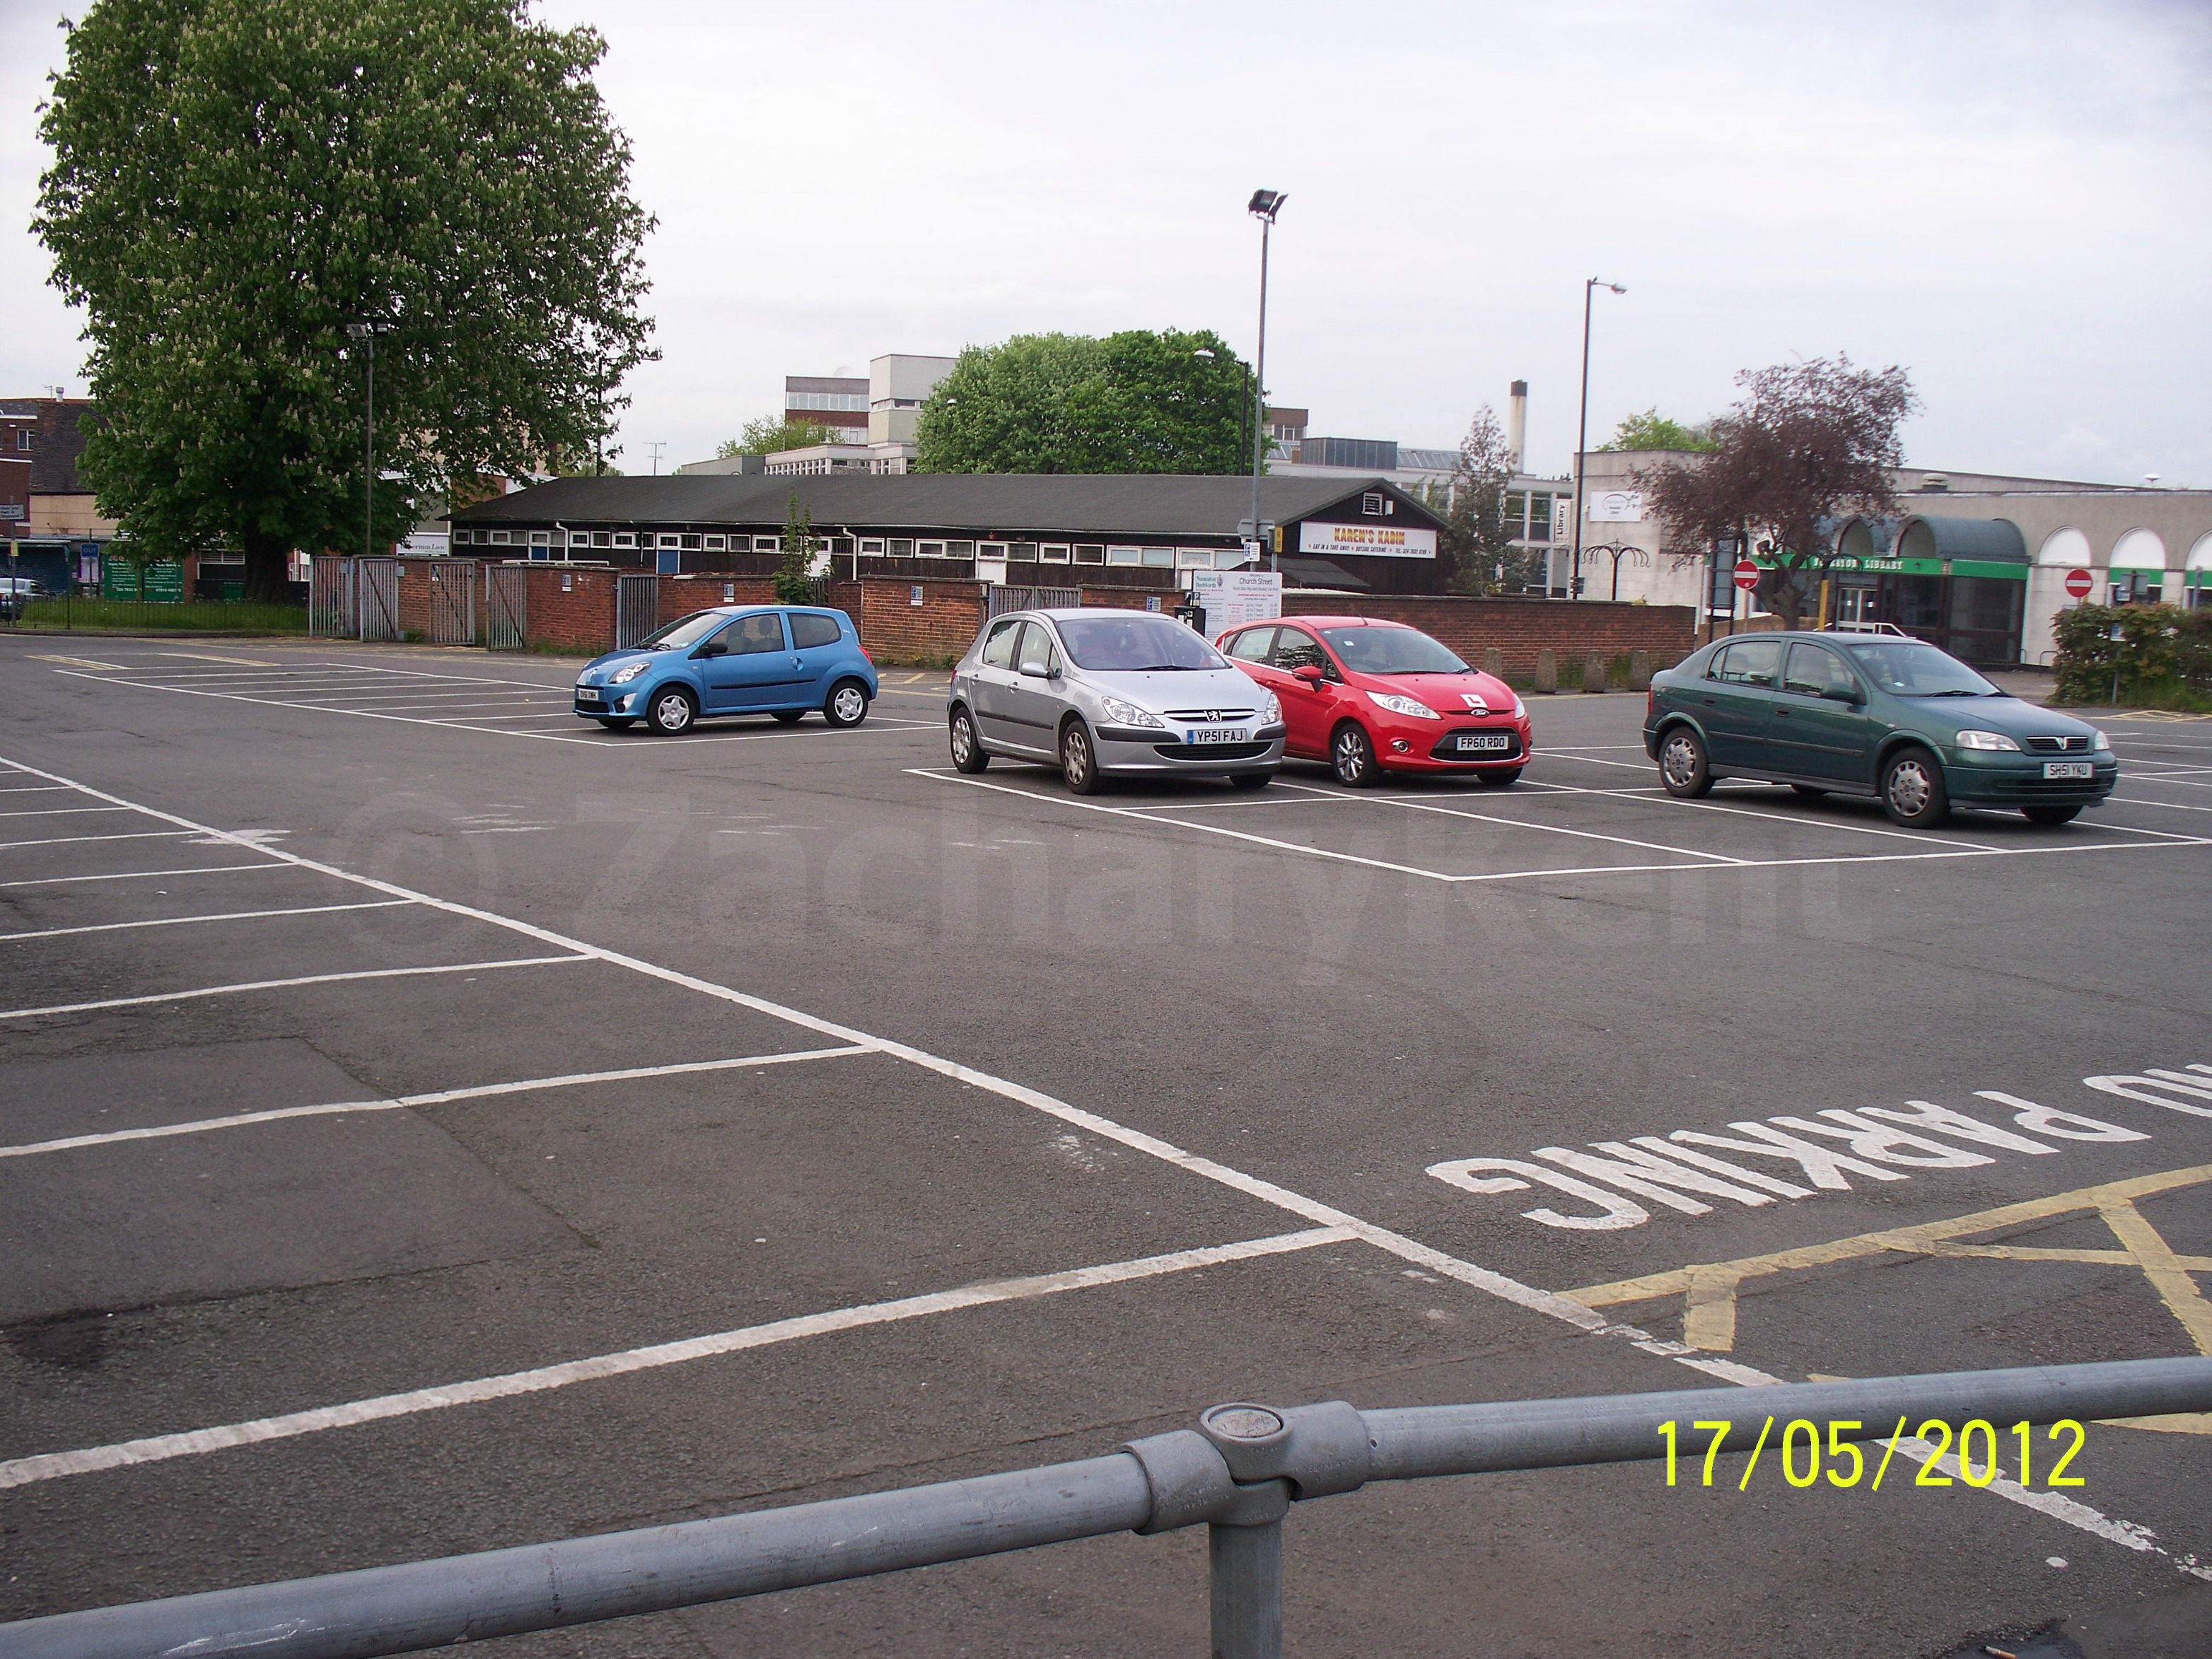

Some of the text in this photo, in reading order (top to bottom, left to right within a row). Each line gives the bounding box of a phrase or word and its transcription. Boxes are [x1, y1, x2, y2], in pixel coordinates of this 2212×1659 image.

[1556, 505, 1565, 535] Library
[1334, 527, 1375, 544] KAREN'S
[1814, 557, 1904, 570] NUEATON LIBRARY
[1197, 730, 1243, 742] YP51 FAJ
[1460, 737, 1504, 748] FP60 RDO
[2049, 764, 2087, 776] SH51 YKU
[1423, 1064, 2212, 1230] O PARKING
